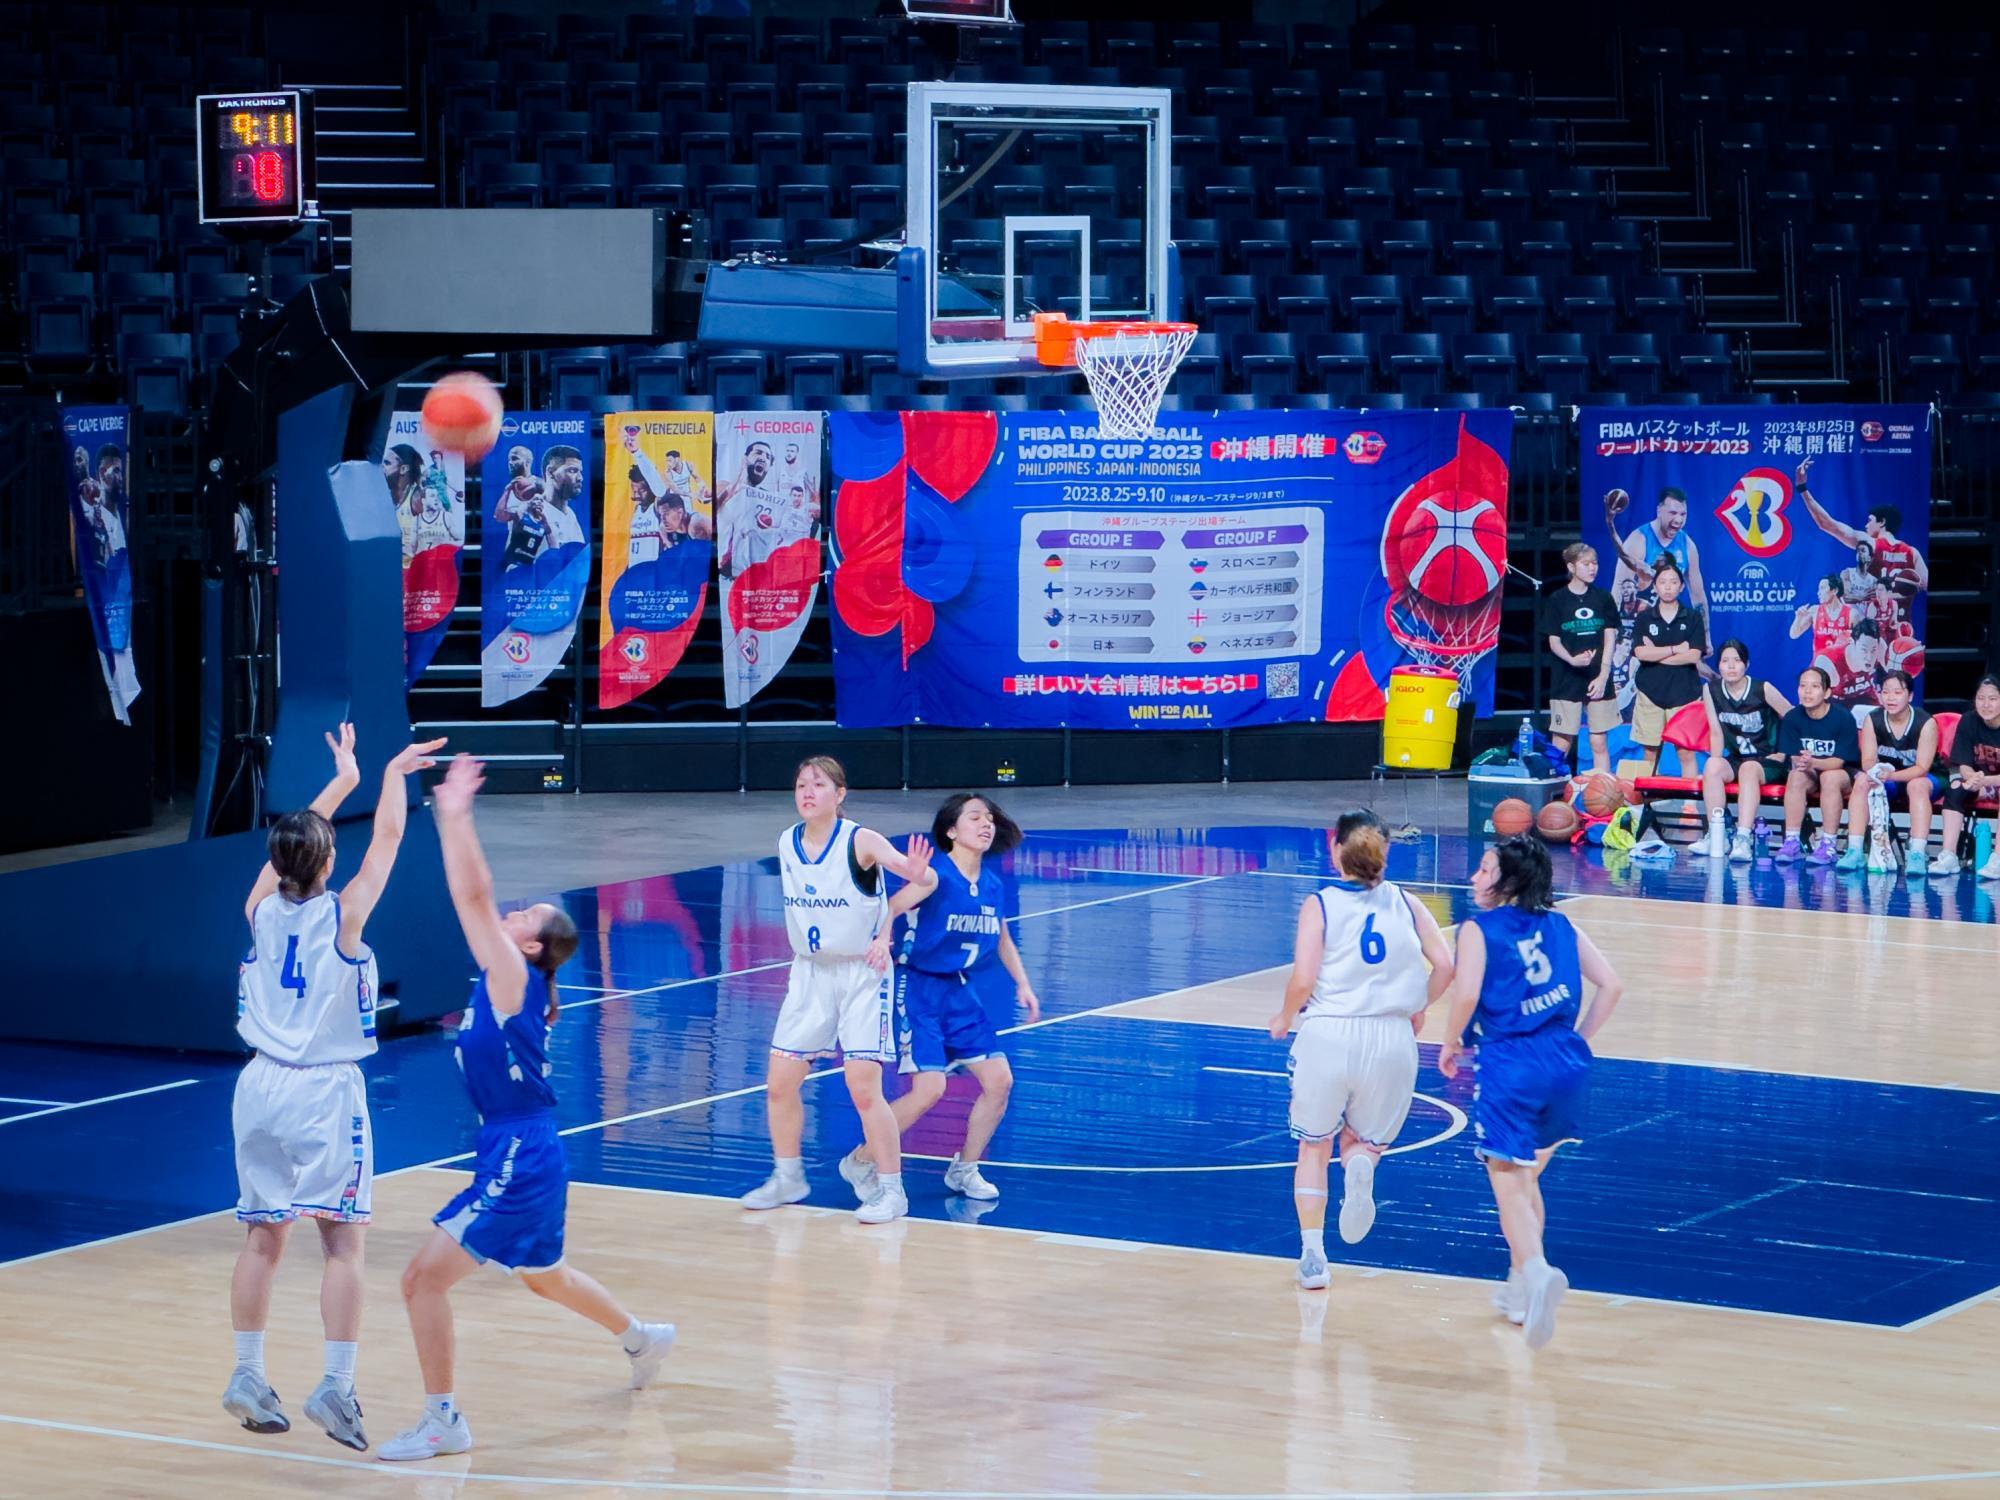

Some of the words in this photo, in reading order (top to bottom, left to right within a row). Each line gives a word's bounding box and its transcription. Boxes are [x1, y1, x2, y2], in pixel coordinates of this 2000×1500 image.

[231, 112, 294, 146] 9:11
[78, 418, 99, 433] CAPE
[100, 416, 124, 431] VERDE
[521, 420, 548, 435] CAPE
[550, 420, 585, 434] VERDE
[645, 422, 706, 435] VENEZUELA
[754, 421, 815, 434] GEORGIA
[1599, 423, 1635, 438] FIBA
[1637, 420, 1750, 437] バスケットボール
[1764, 420, 1855, 435] 2023年8月25日
[1018, 426, 1067, 441] FIBA
[1018, 443, 1096, 460] WORLD
[1100, 443, 1144, 460] CUP
[1148, 443, 1203, 460] 2023
[1218, 433, 1326, 462] 沖縄開催
[1601, 438, 1711, 457] ワールドカップ
[1711, 439, 1750, 455] 2023
[1062, 486, 1166, 503] 2023.8.25-9.10
[1069, 533, 1121, 547] GROUP
[1123, 533, 1133, 547] E
[1214, 531, 1265, 546] GROUP
[1266, 530, 1277, 543] F
[1089, 559, 1121, 570] ドイツ
[1221, 555, 1278, 568] スロベニア
[1743, 568, 1764, 580] FIBA
[1074, 586, 1136, 598] フィンランド
[1711, 581, 1795, 589] BASKETBALL
[1710, 589, 1764, 603] WORLD
[1767, 589, 1797, 602] CUP
[1067, 612, 1142, 625] オーストラリア
[1221, 610, 1276, 623] ジョージア
[1092, 639, 1115, 651] 日本
[1220, 636, 1275, 649] ベネズエラ
[1129, 705, 1159, 720] WIN
[1161, 705, 1180, 715] FOR
[1182, 705, 1213, 720] ALL
[784, 896, 850, 909] OKINAWA
[808, 925, 821, 954] 8
[1360, 911, 1386, 965] 6
[960, 942, 979, 969] 7
[1516, 930, 1553, 987] 5
[280, 935, 307, 999] 4
